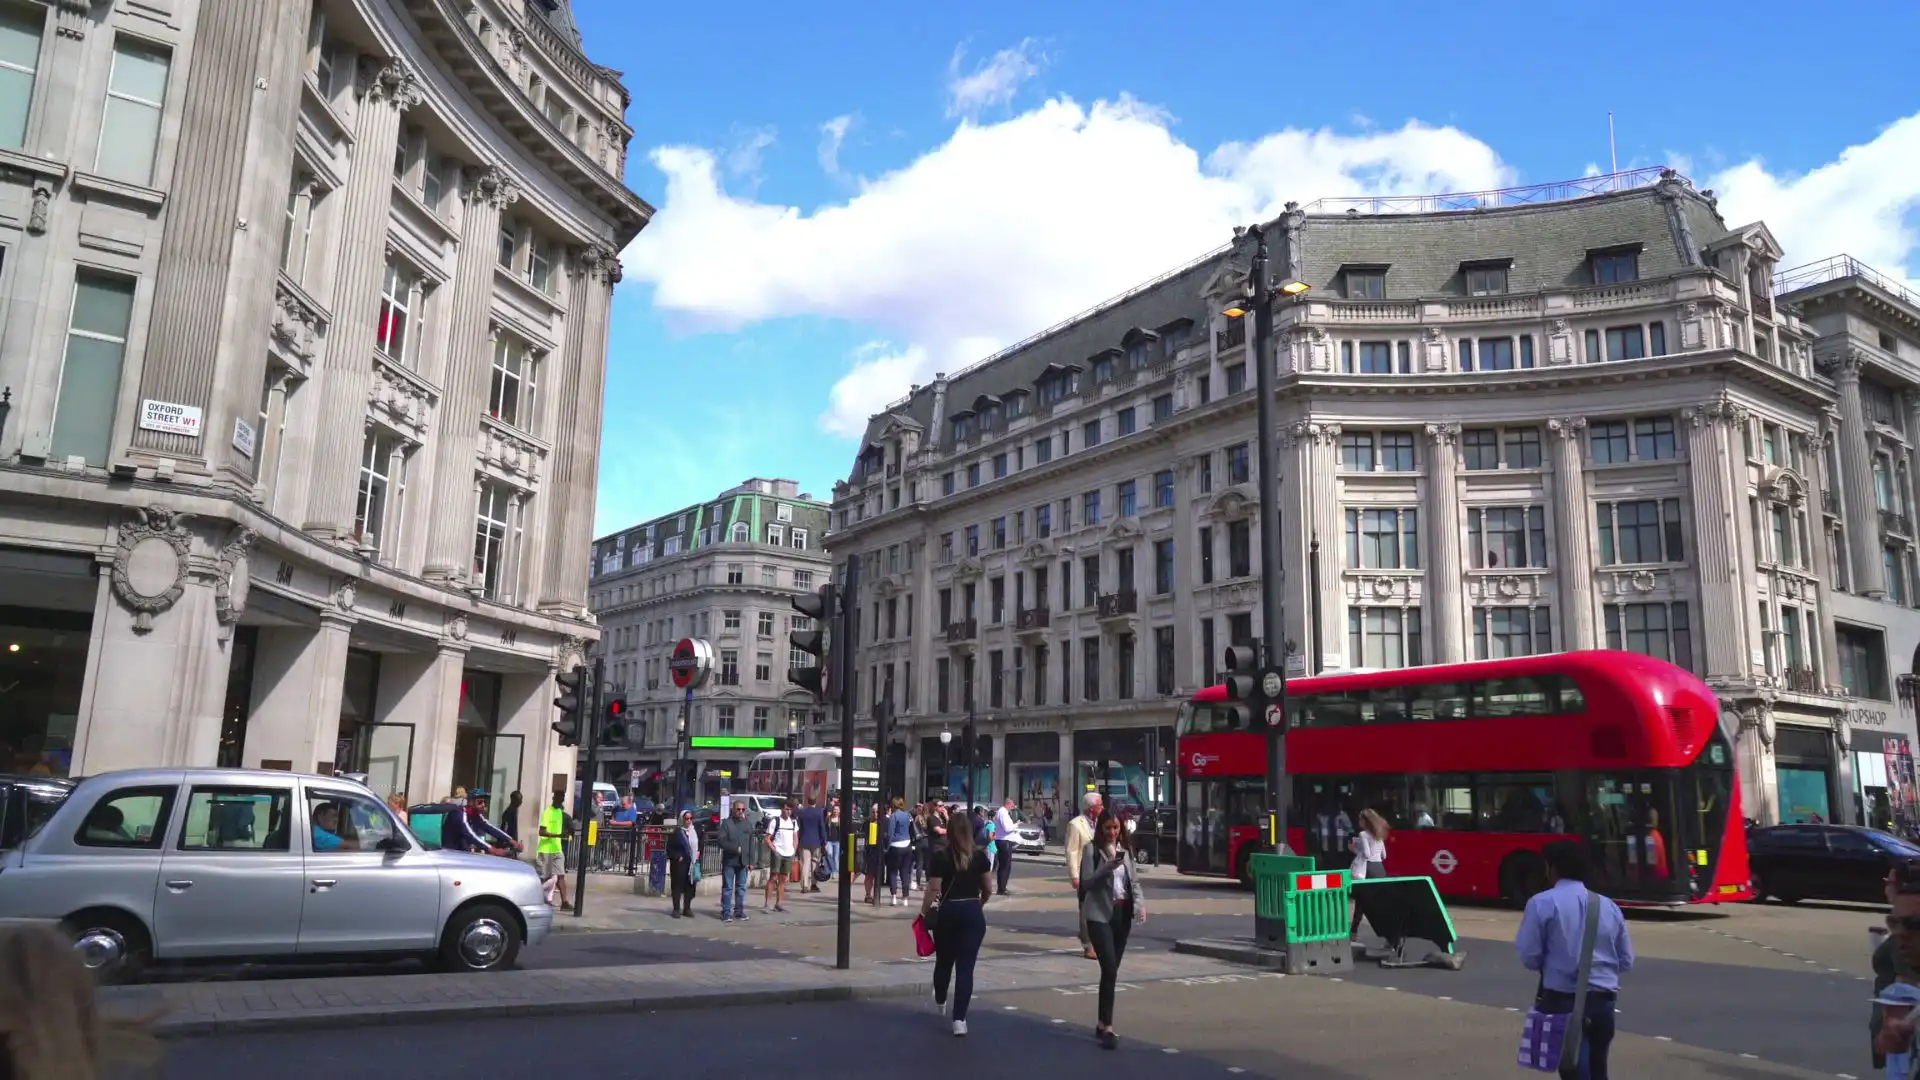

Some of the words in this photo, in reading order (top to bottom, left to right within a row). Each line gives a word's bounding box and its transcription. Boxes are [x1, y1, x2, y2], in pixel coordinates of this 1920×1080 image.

[148, 403, 183, 415] OXFORD
[147, 411, 180, 423] STREET
[182, 417, 196, 426] W1
